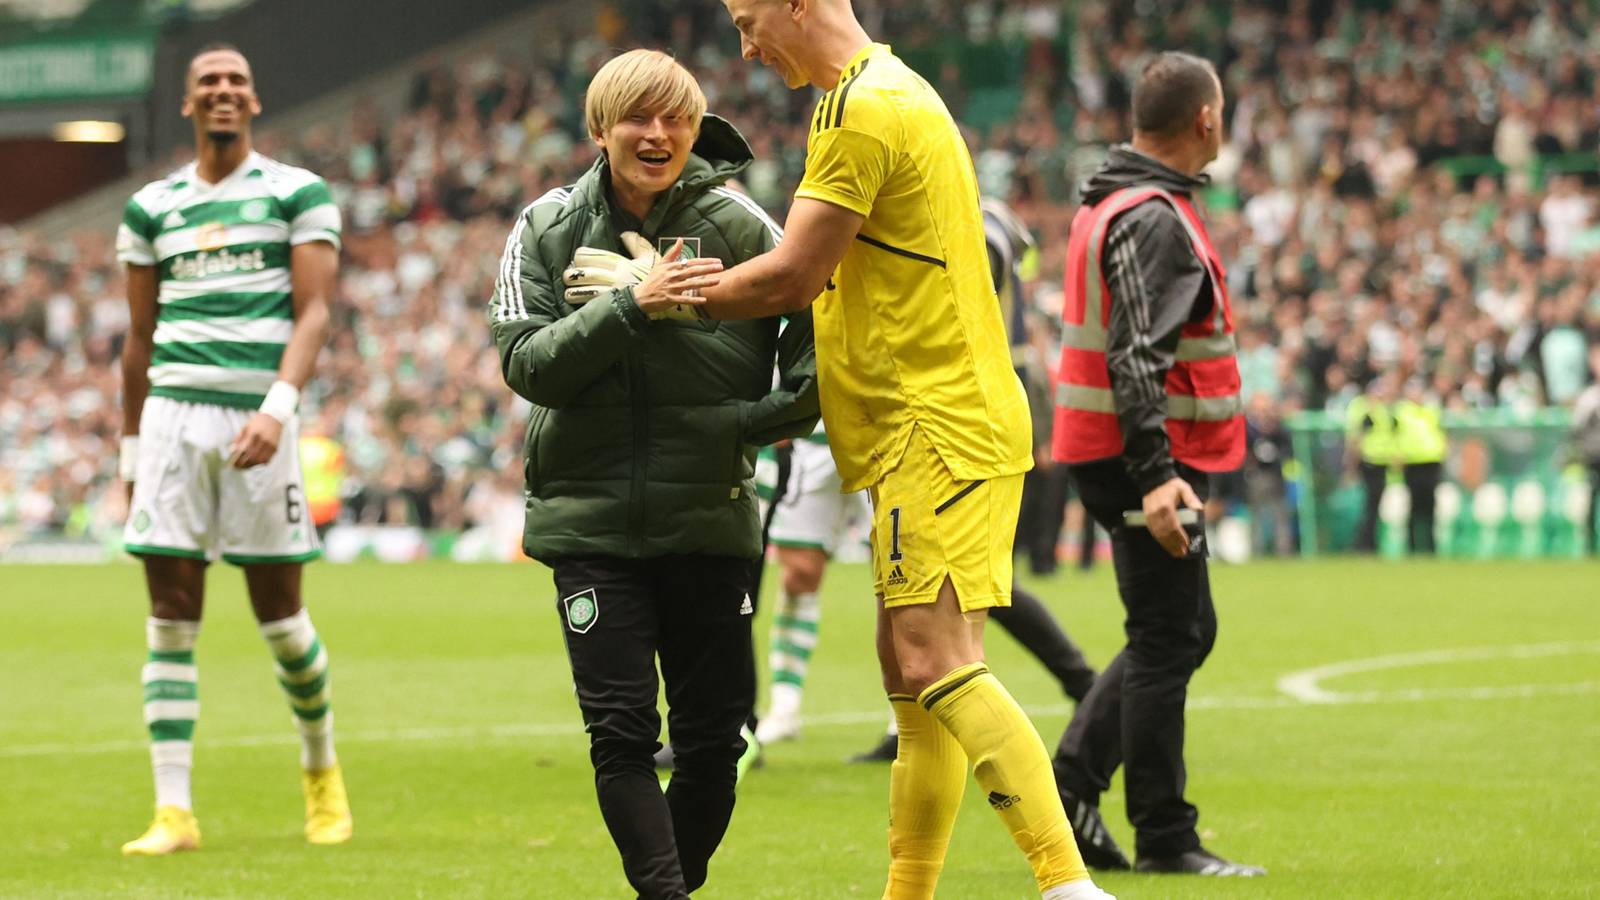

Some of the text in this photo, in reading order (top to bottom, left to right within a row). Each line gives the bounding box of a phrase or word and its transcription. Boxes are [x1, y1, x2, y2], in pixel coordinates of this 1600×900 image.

[170, 248, 265, 280] dafabet
[285, 484, 301, 523] 6
[889, 507, 903, 562] 1
